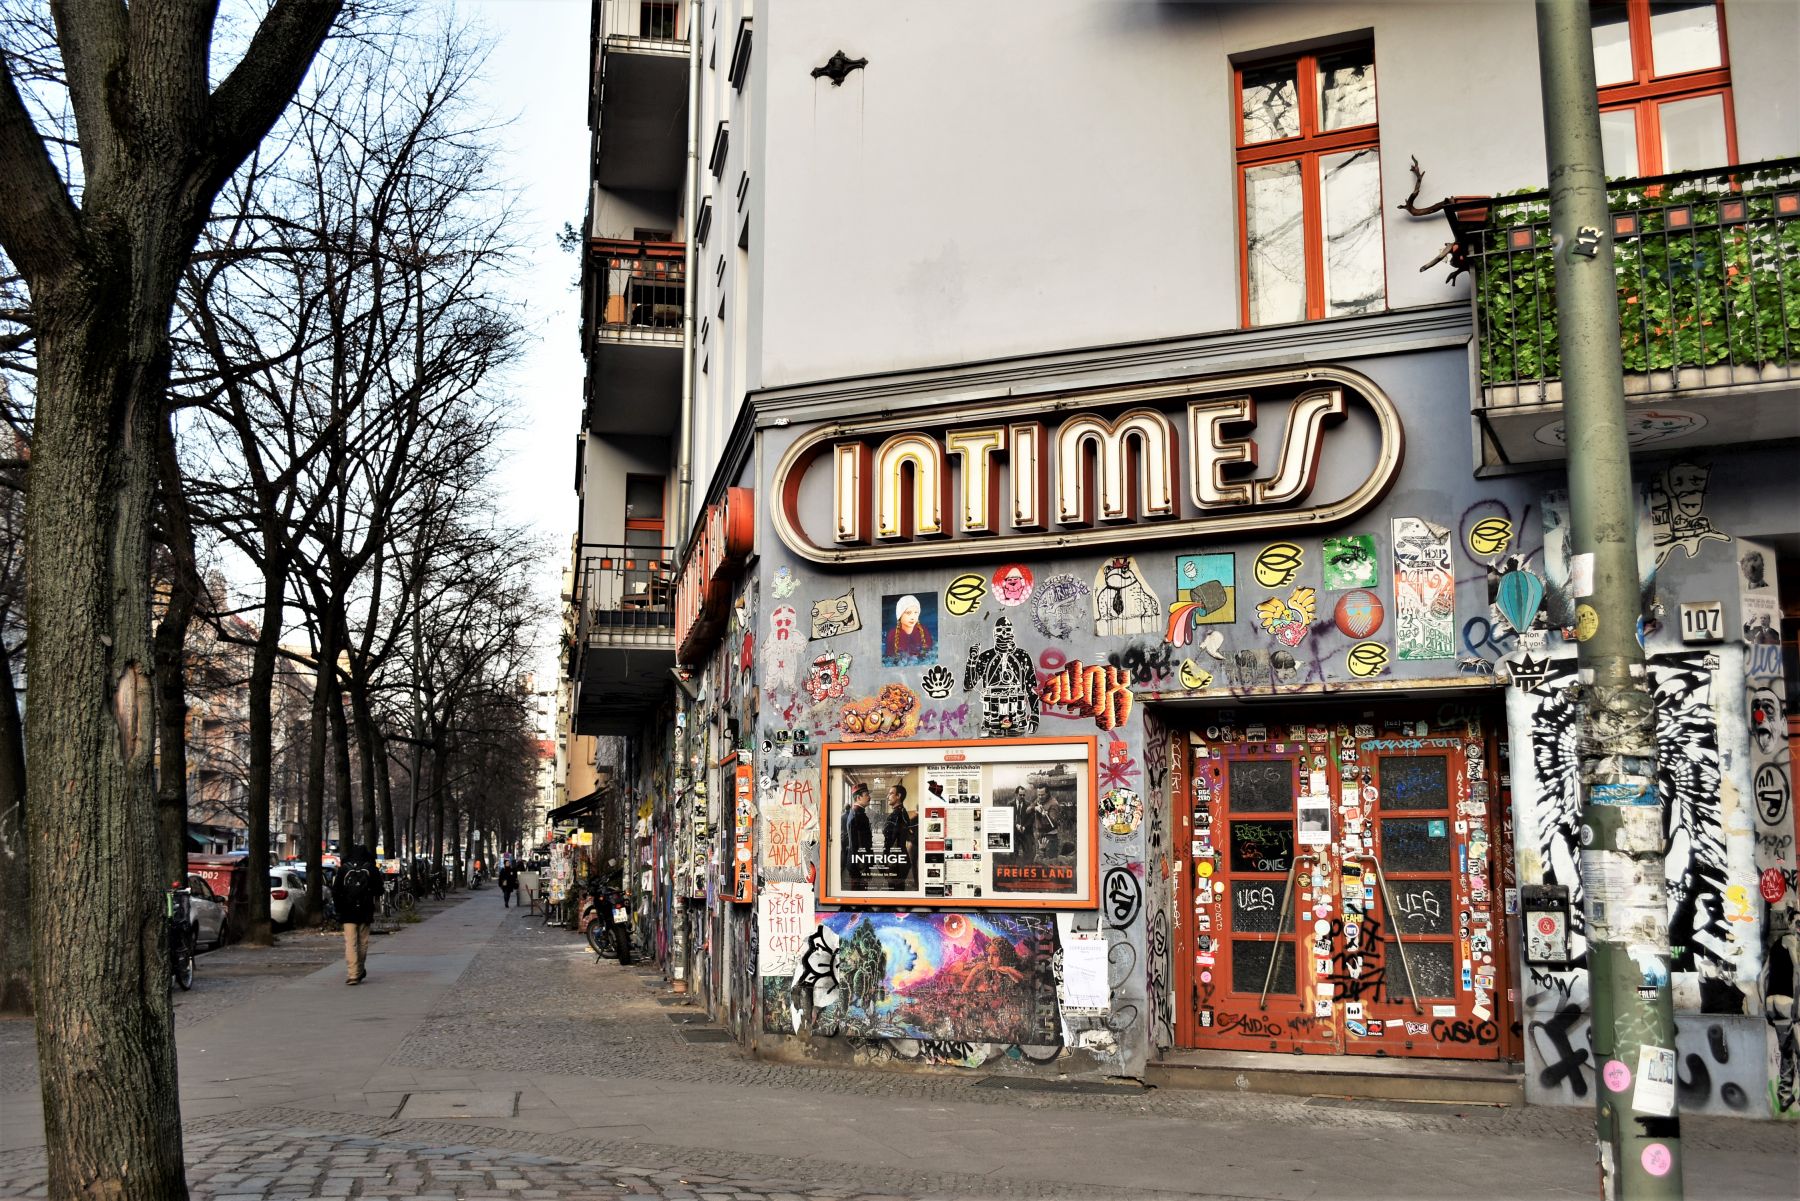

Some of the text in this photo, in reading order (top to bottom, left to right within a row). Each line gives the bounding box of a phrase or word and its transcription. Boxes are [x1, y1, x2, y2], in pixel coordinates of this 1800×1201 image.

[834, 386, 1347, 544] INTIMES
[1684, 609, 1719, 632] 107
[851, 854, 908, 864] INTRIGE
[996, 867, 1074, 878] FREIES LAND
